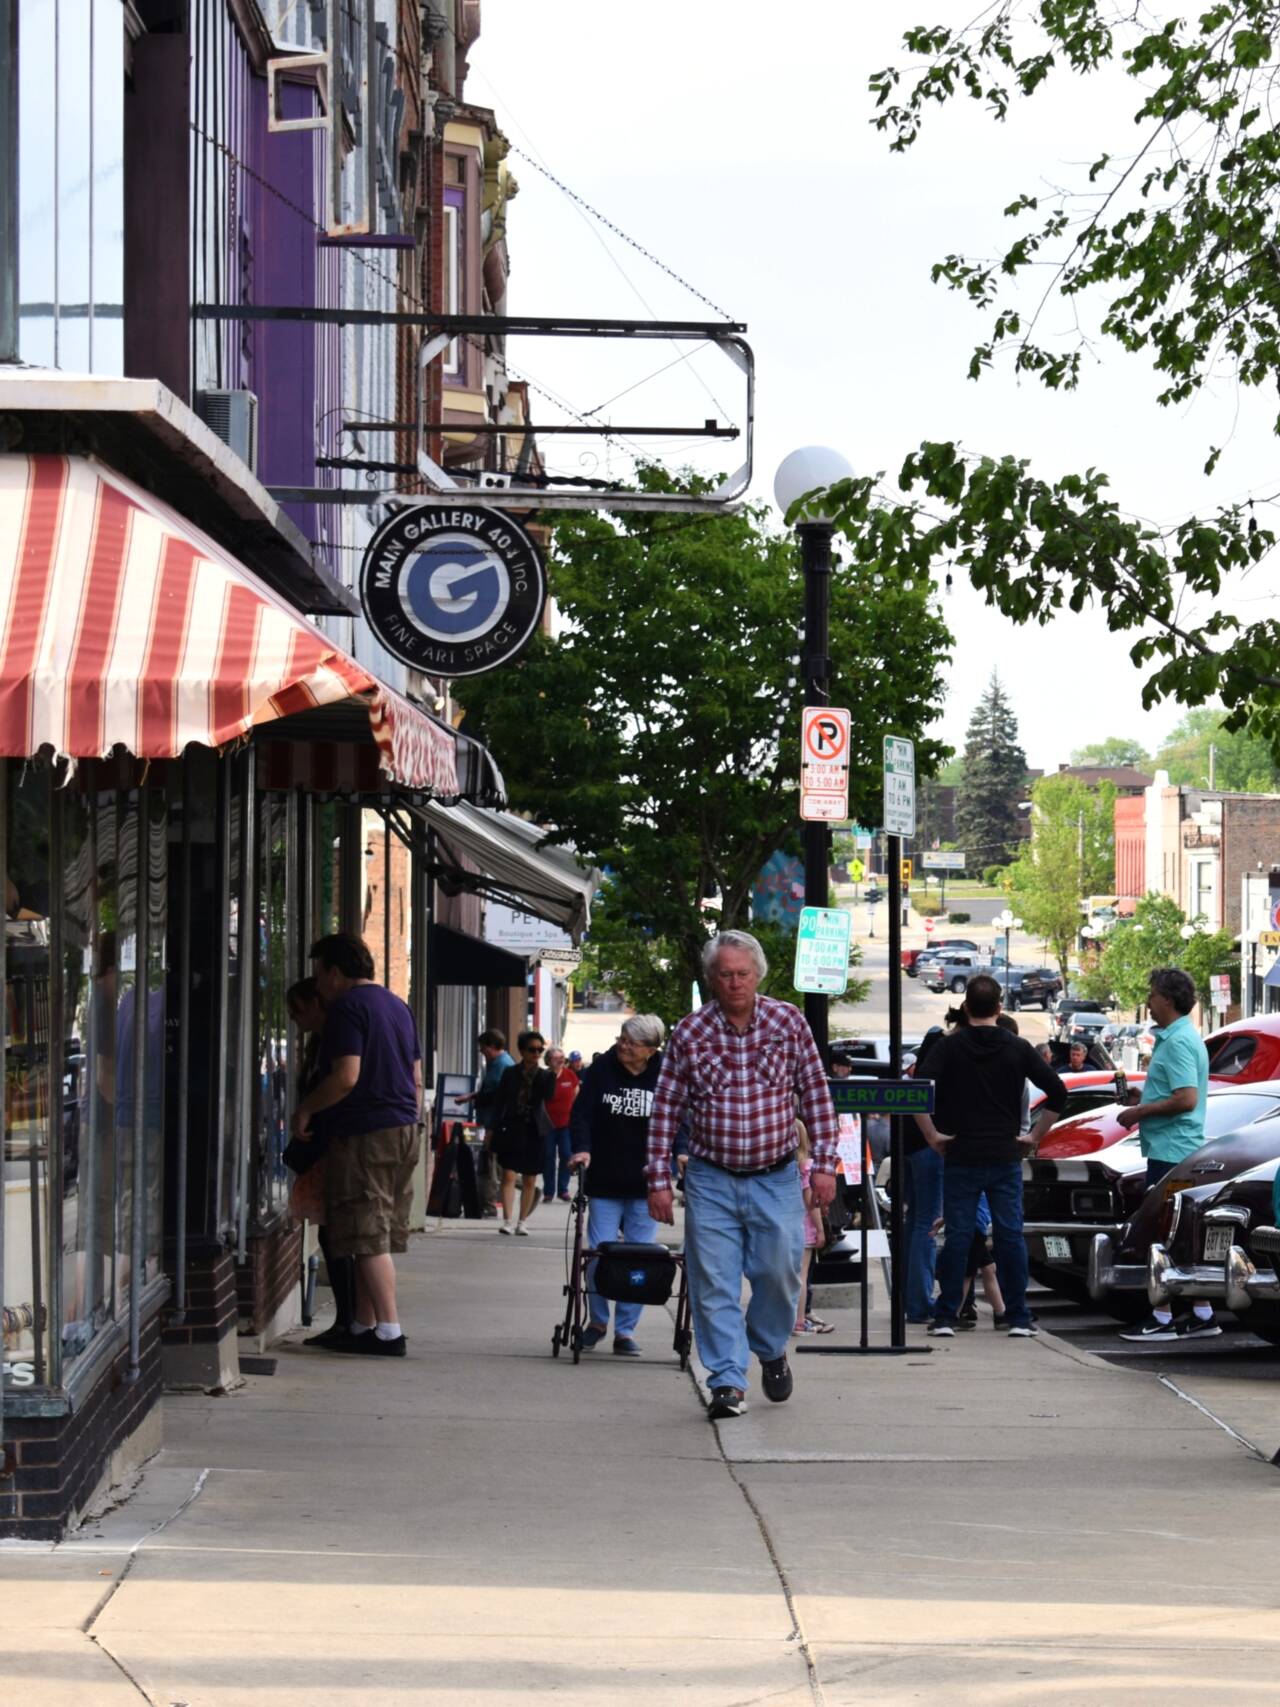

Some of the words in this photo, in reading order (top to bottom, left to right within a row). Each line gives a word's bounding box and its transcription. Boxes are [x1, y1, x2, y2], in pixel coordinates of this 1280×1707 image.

[374, 539, 405, 589] MAIN
[404, 511, 486, 540] GALLERY
[488, 527, 520, 559] 404
[384, 614, 420, 650] FINE
[422, 646, 455, 664] ART
[464, 621, 517, 663] SPACE
[829, 765, 840, 774] AM
[805, 776, 814, 787] TO
[833, 778, 844, 787] AM
[898, 779, 906, 791] AM
[888, 791, 895, 805] TO
[902, 795, 911, 807] PM
[511, 911, 541, 924] PE
[800, 915, 816, 931] 90
[816, 926, 848, 938] PARKING
[827, 943, 839, 953] AM
[801, 953, 810, 964] TO
[832, 956, 844, 967] PM
[620, 1088, 642, 1099] THE
[884, 1088, 929, 1103] OPEN
[602, 1093, 642, 1108] NORTH
[611, 1104, 642, 1117] FACE
